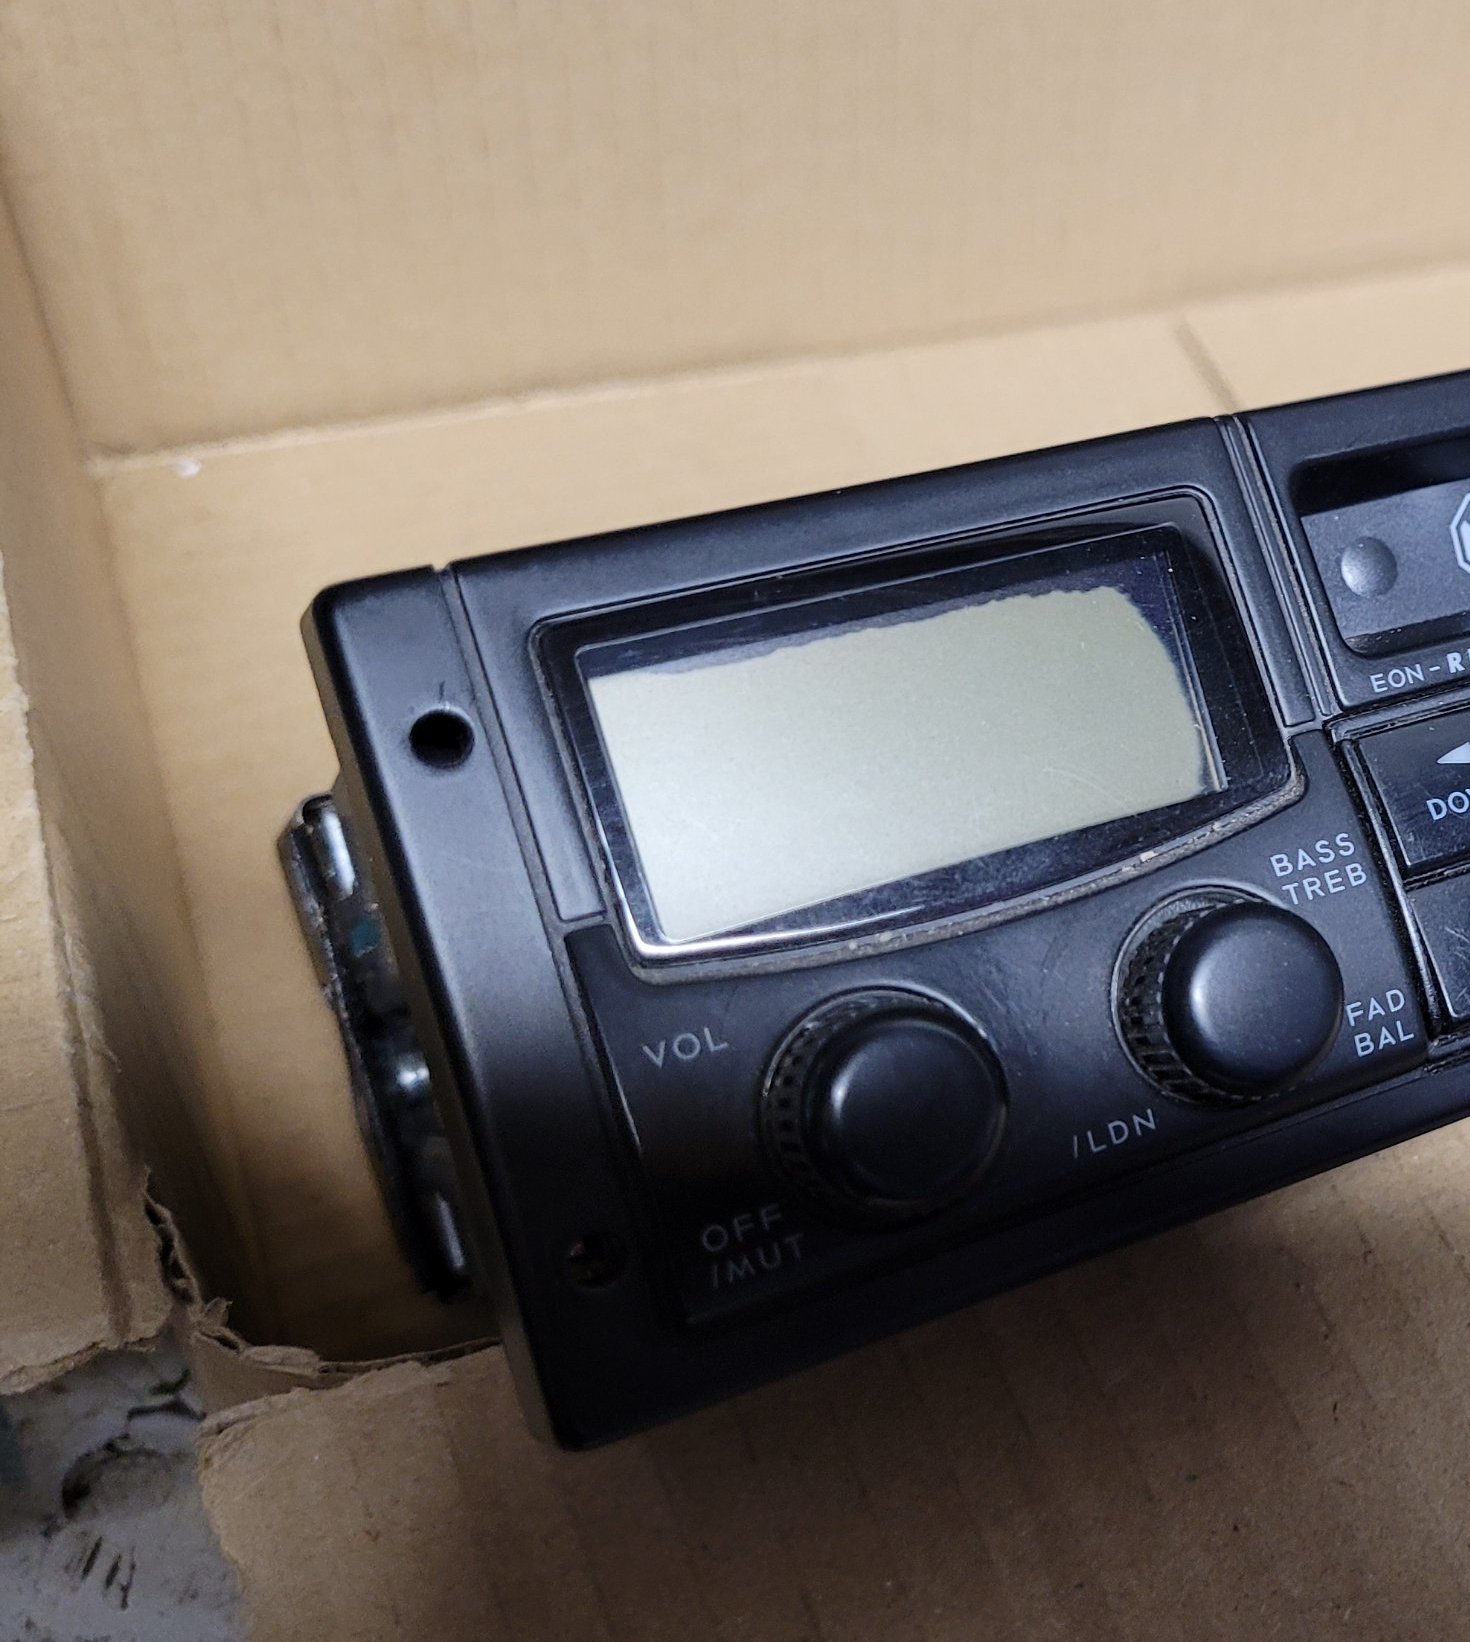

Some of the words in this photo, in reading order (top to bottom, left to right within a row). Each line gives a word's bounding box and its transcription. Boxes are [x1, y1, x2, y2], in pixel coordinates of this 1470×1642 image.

[1270, 832, 1356, 877] BASS
[1282, 861, 1367, 906] TREB
[1345, 988, 1405, 1027] FAD
[642, 1025, 730, 1068] VOL
[1354, 1024, 1416, 1057] BAL
[700, 1202, 785, 1252] OFF
